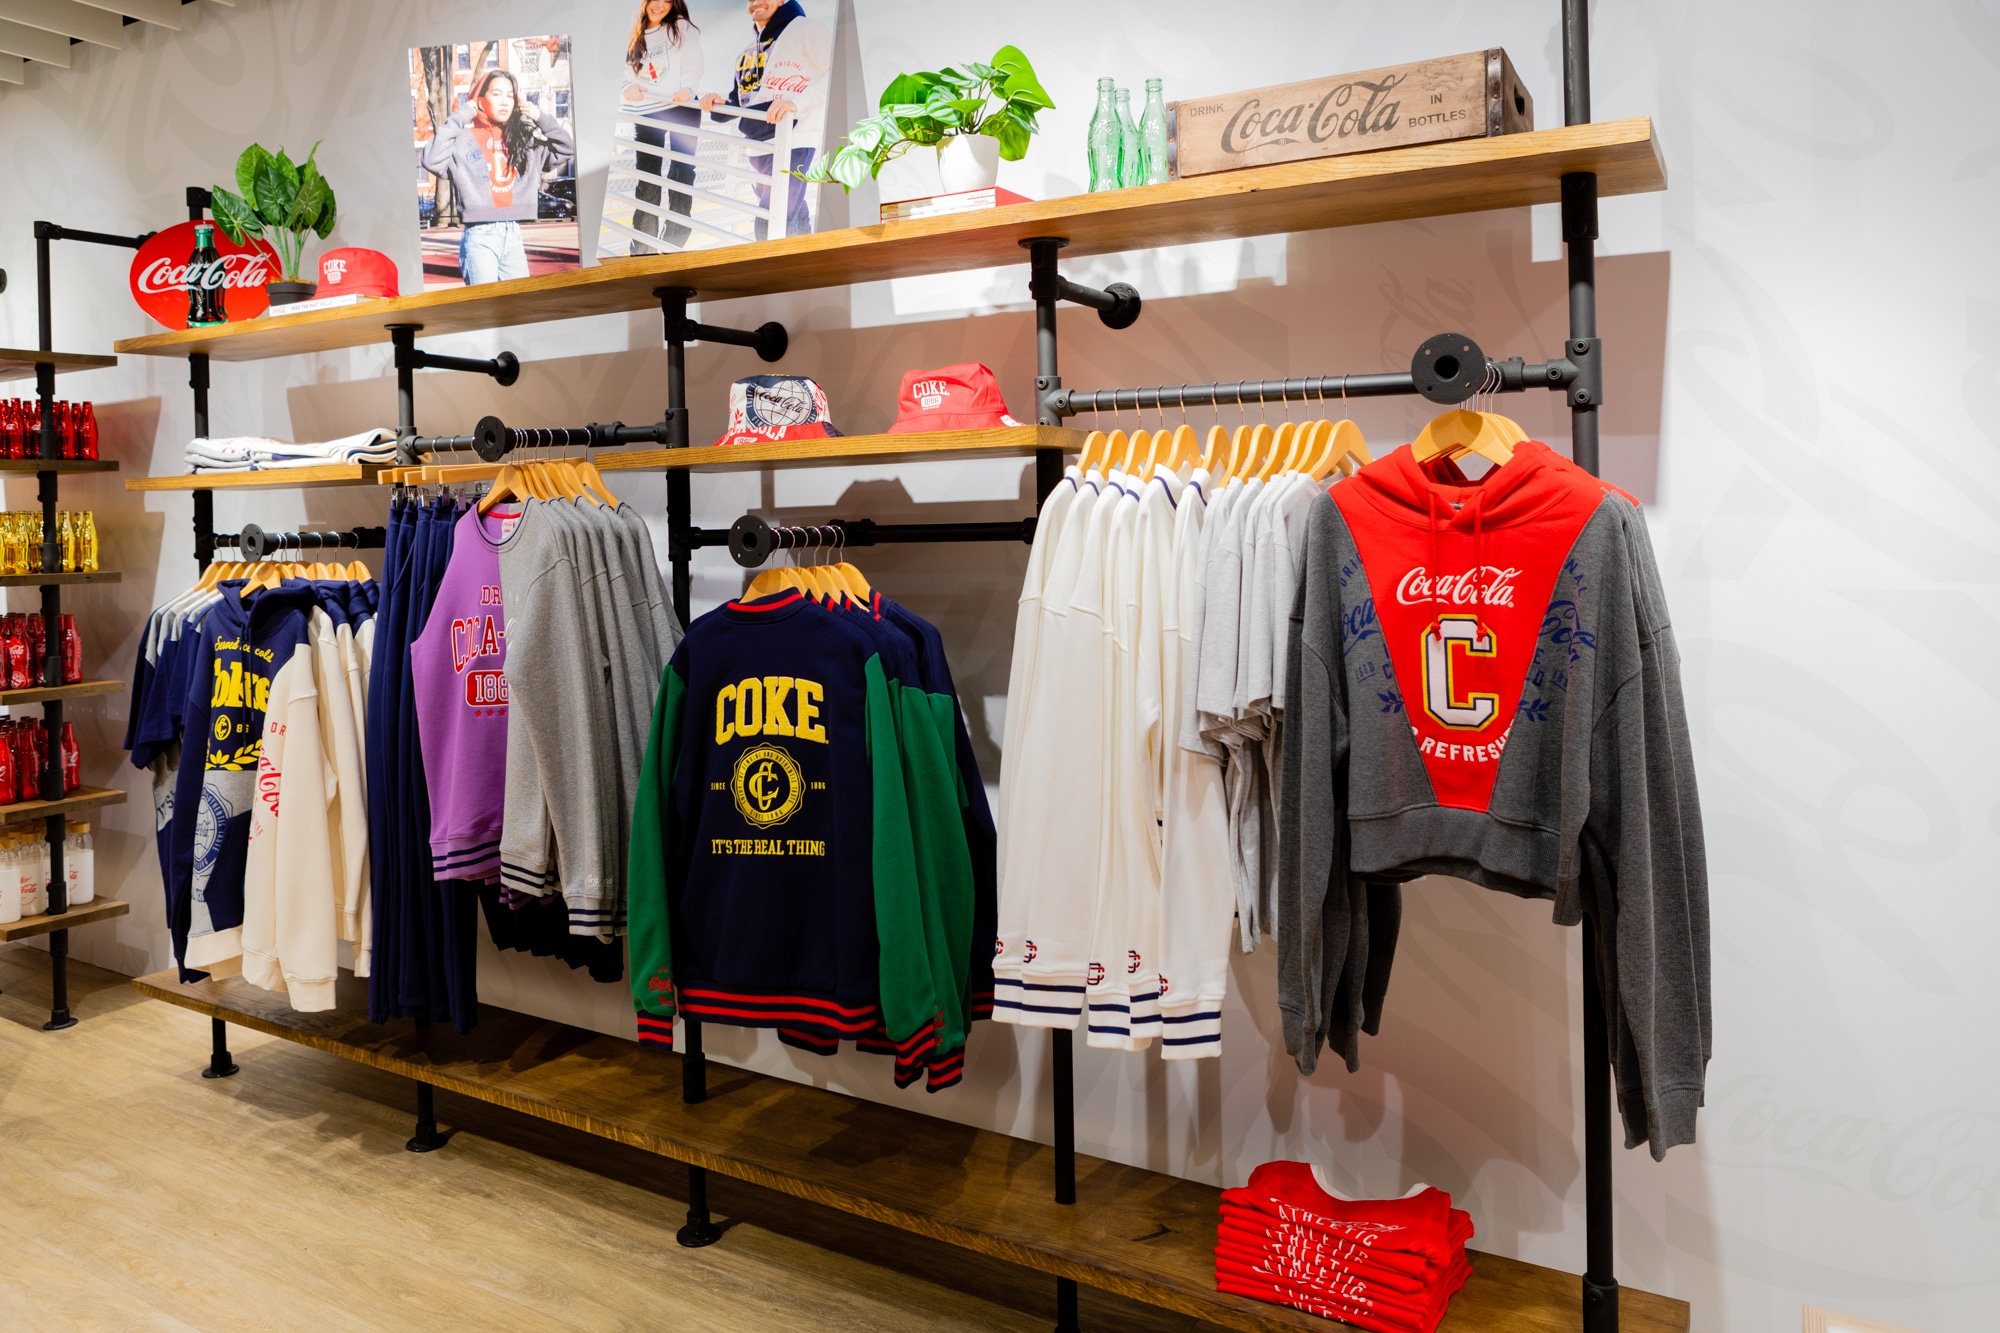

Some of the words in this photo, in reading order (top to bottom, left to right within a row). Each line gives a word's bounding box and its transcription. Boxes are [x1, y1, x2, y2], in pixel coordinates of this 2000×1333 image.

[1430, 93, 1443, 105] IN
[1190, 103, 1224, 118] DRINK
[1220, 72, 1408, 155] Coca-Cola
[1408, 109, 1467, 128] BOTTLES
[138, 252, 272, 294] Coca-Cola
[323, 259, 347, 274] COKE
[913, 379, 950, 399] COKE
[1396, 565, 1523, 606] Coca-Cola
[254, 648, 274, 663] cold
[1420, 613, 1500, 732] C
[474, 674, 509, 702] 188
[715, 676, 827, 746] COKE
[1420, 718, 1514, 763] REFRESH
[710, 781, 726, 791] SINCE
[711, 839, 733, 855] IT'S
[733, 839, 753, 855] THE
[753, 839, 785, 856] REAL
[786, 840, 826, 857] THING
